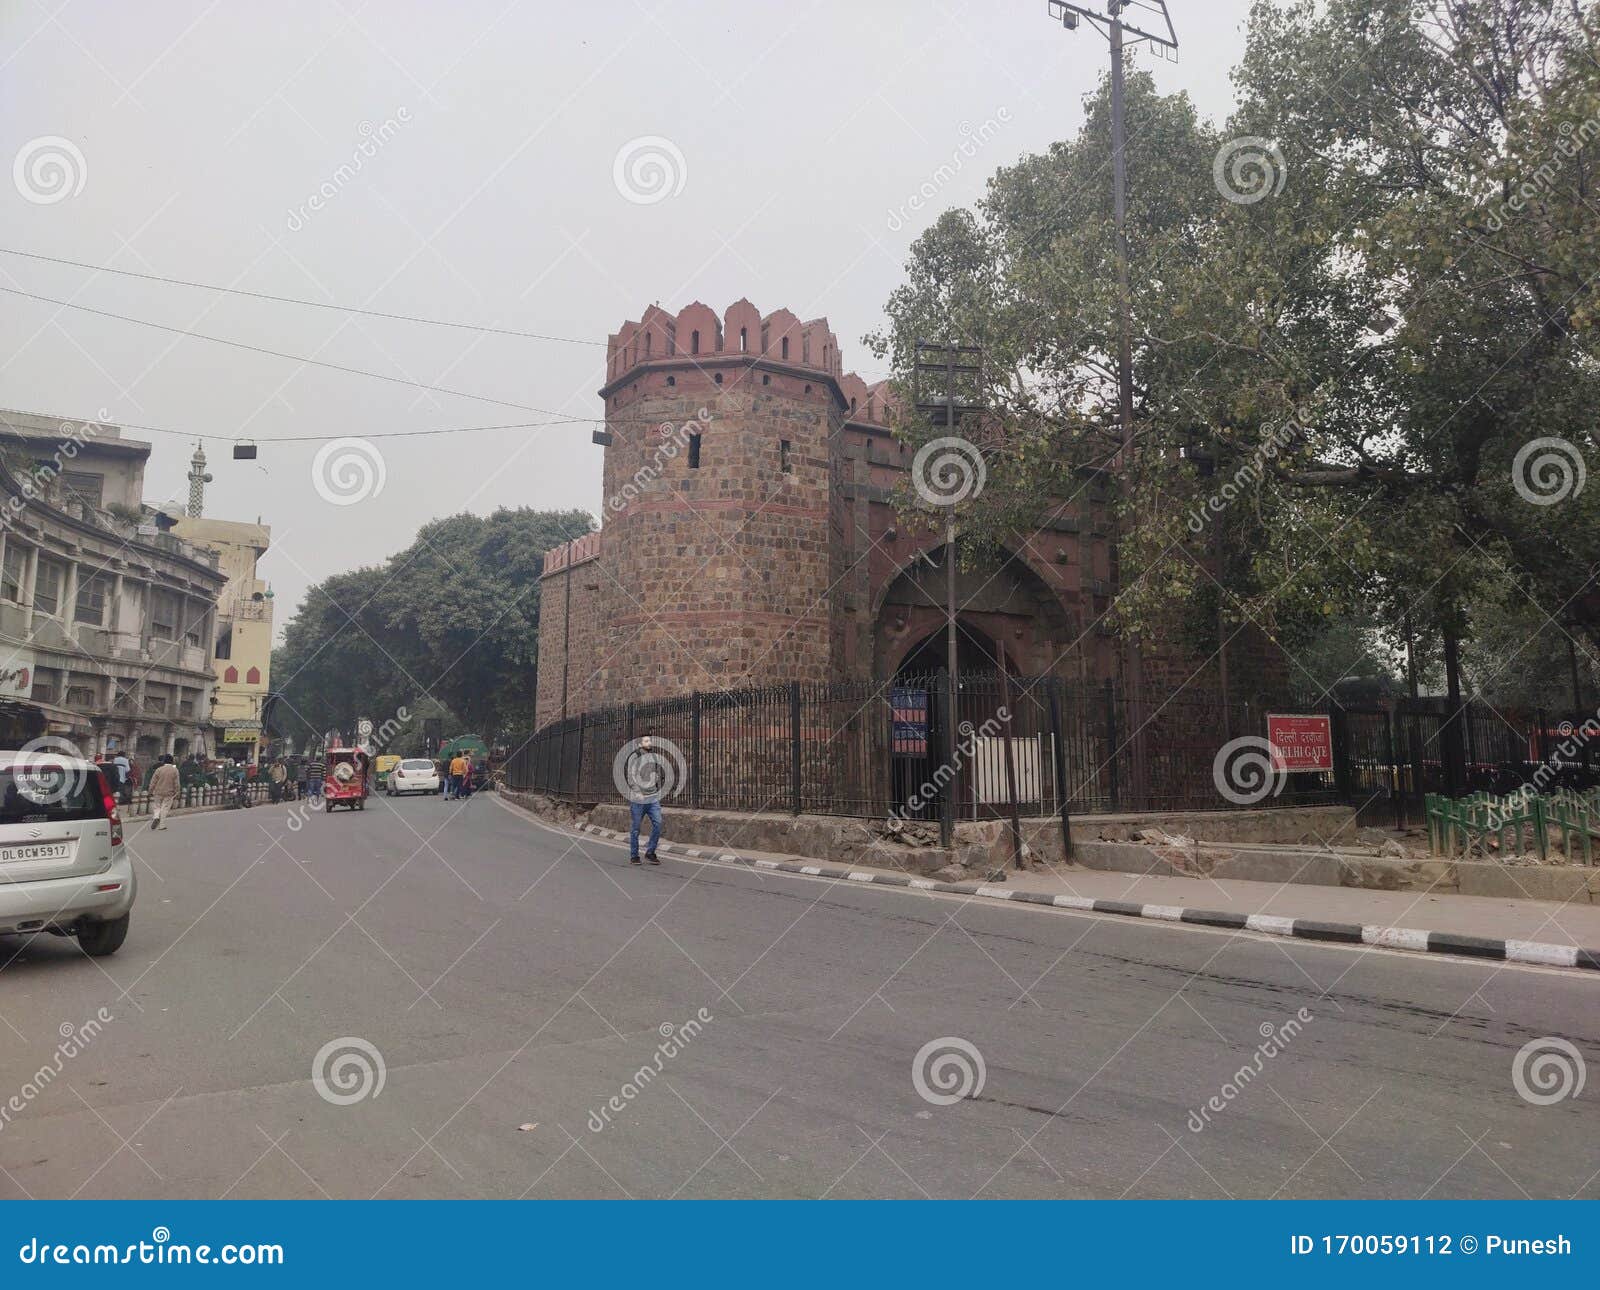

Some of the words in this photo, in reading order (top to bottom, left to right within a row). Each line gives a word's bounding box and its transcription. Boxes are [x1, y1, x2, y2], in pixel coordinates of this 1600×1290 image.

[1274, 745, 1303, 758] DELHI
[1304, 745, 1328, 758] GATE
[17, 773, 41, 782] GURU
